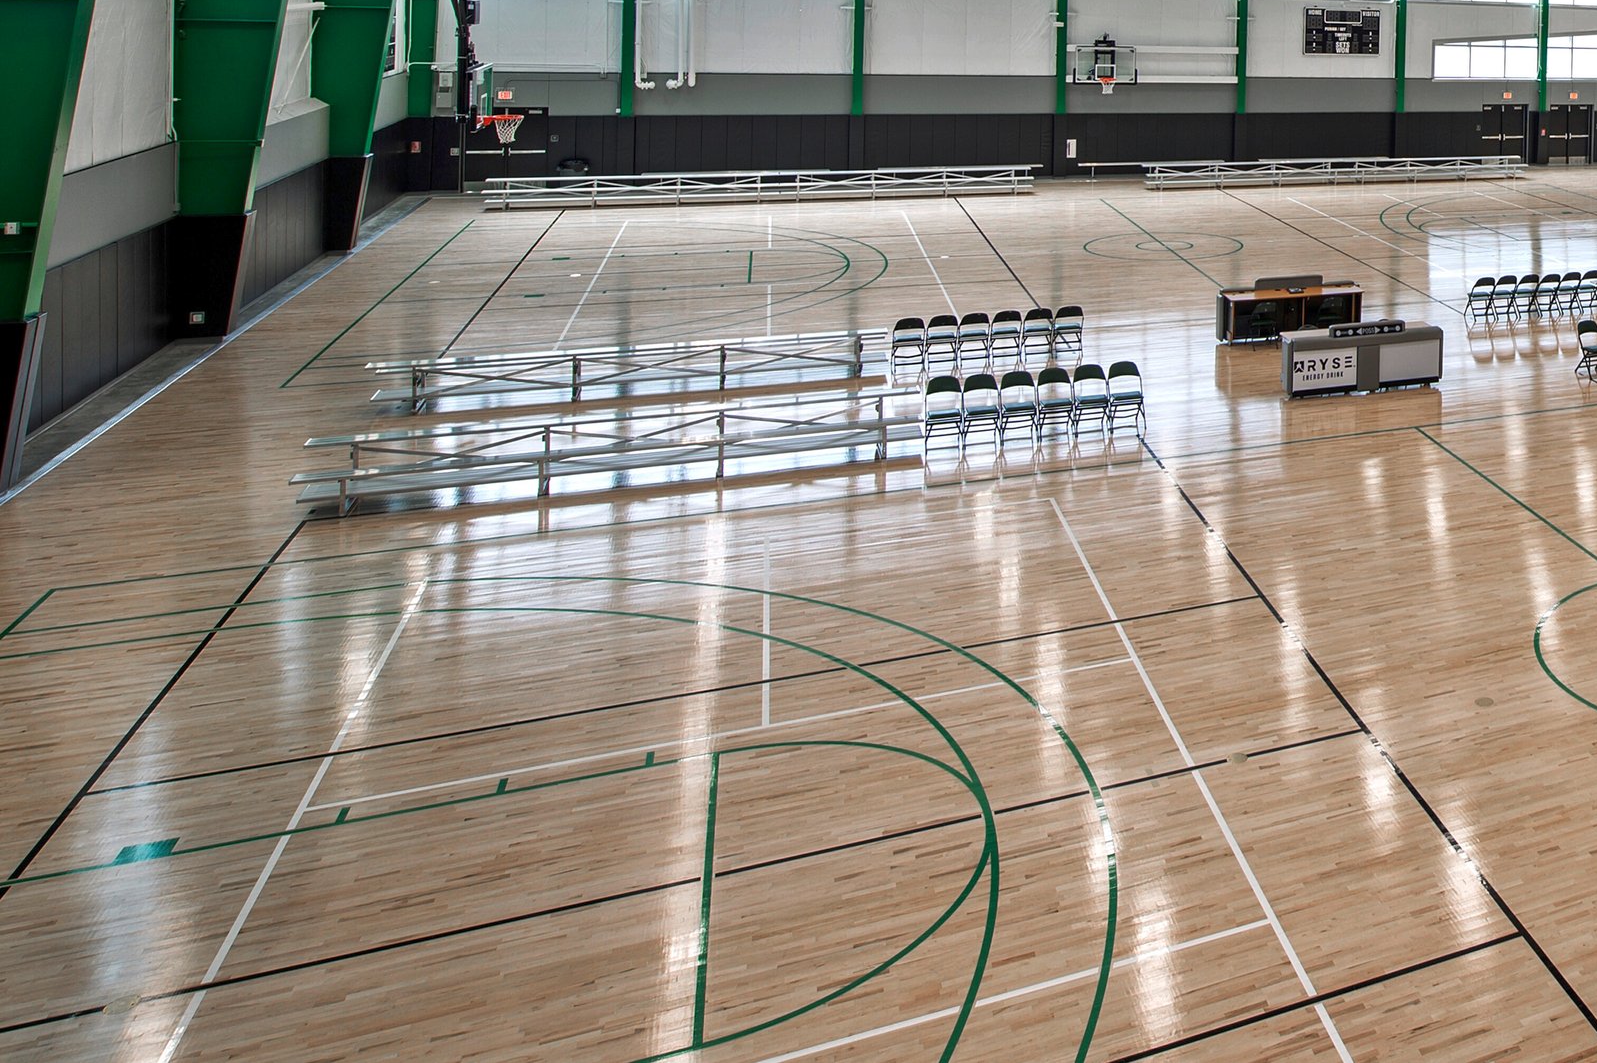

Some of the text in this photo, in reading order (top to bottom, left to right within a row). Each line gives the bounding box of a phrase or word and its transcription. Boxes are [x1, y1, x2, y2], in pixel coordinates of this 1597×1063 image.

[1307, 356, 1353, 372] RYSE
[1302, 371, 1343, 381] ENERGY DRINK
